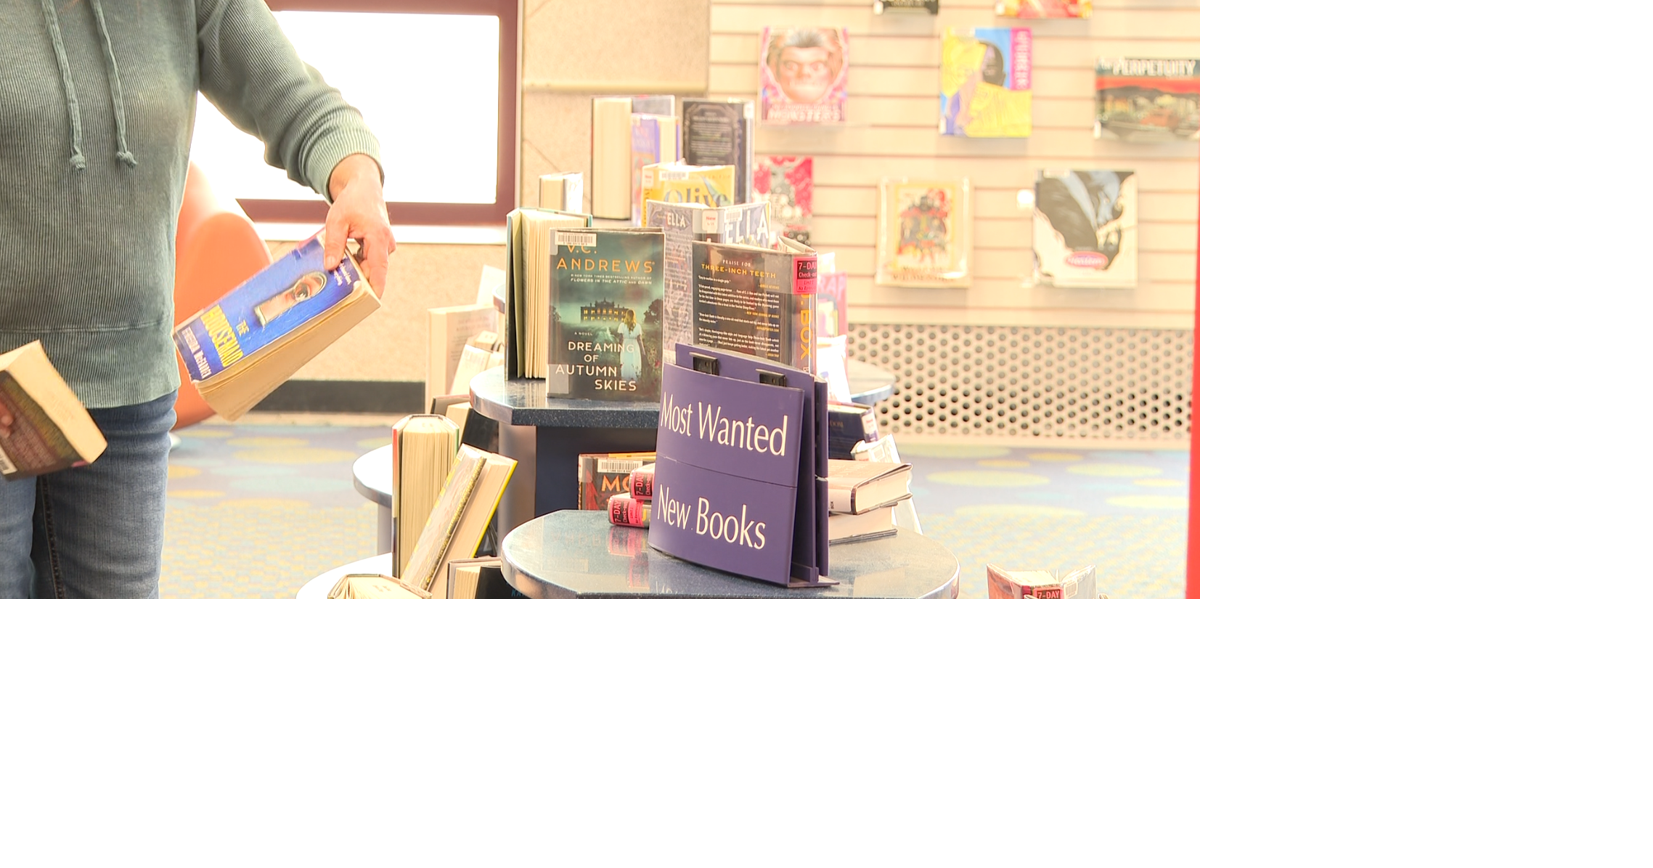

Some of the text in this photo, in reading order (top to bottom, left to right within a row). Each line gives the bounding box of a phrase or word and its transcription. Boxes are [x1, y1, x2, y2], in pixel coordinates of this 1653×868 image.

[1112, 59, 1196, 76] PERPETUITY
[667, 212, 686, 228] ELLA
[725, 208, 769, 243] ELLA
[556, 258, 653, 273] ANDREWS
[701, 264, 776, 278] THREE-INCH TEETH
[200, 304, 244, 368] HOUSEMAID
[236, 320, 249, 336] THE
[181, 326, 200, 354] FREIDA
[568, 342, 634, 353] DREAMING
[584, 354, 599, 363] OF
[556, 365, 617, 377] AUTUMN
[594, 380, 637, 391] SKIES
[660, 392, 788, 456] Most Wanted
[657, 484, 766, 550] New Books
[1038, 591, 1059, 599] 7-DAY
